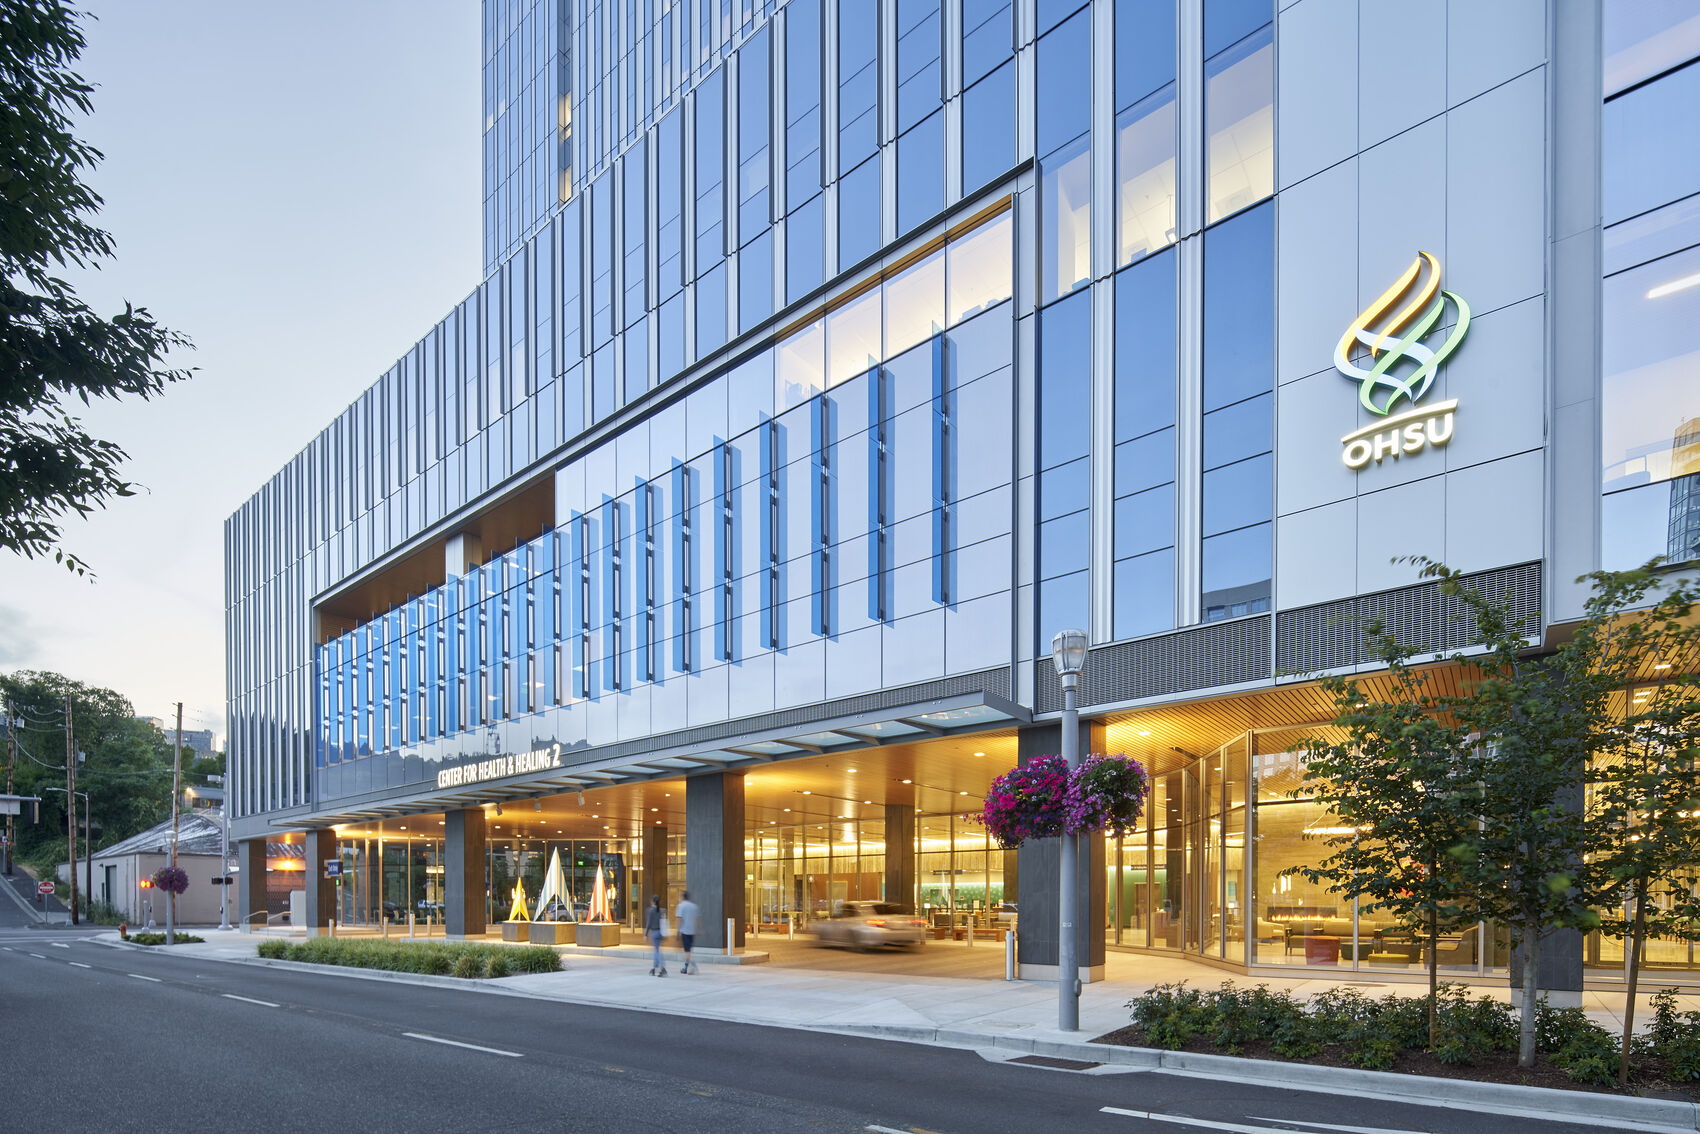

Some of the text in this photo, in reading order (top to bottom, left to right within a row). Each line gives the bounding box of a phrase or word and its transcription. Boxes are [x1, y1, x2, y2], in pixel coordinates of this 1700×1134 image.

[1342, 412, 1454, 469] OHSU
[438, 743, 561, 788] CENTER FOR HEALTH & HEALING 2
